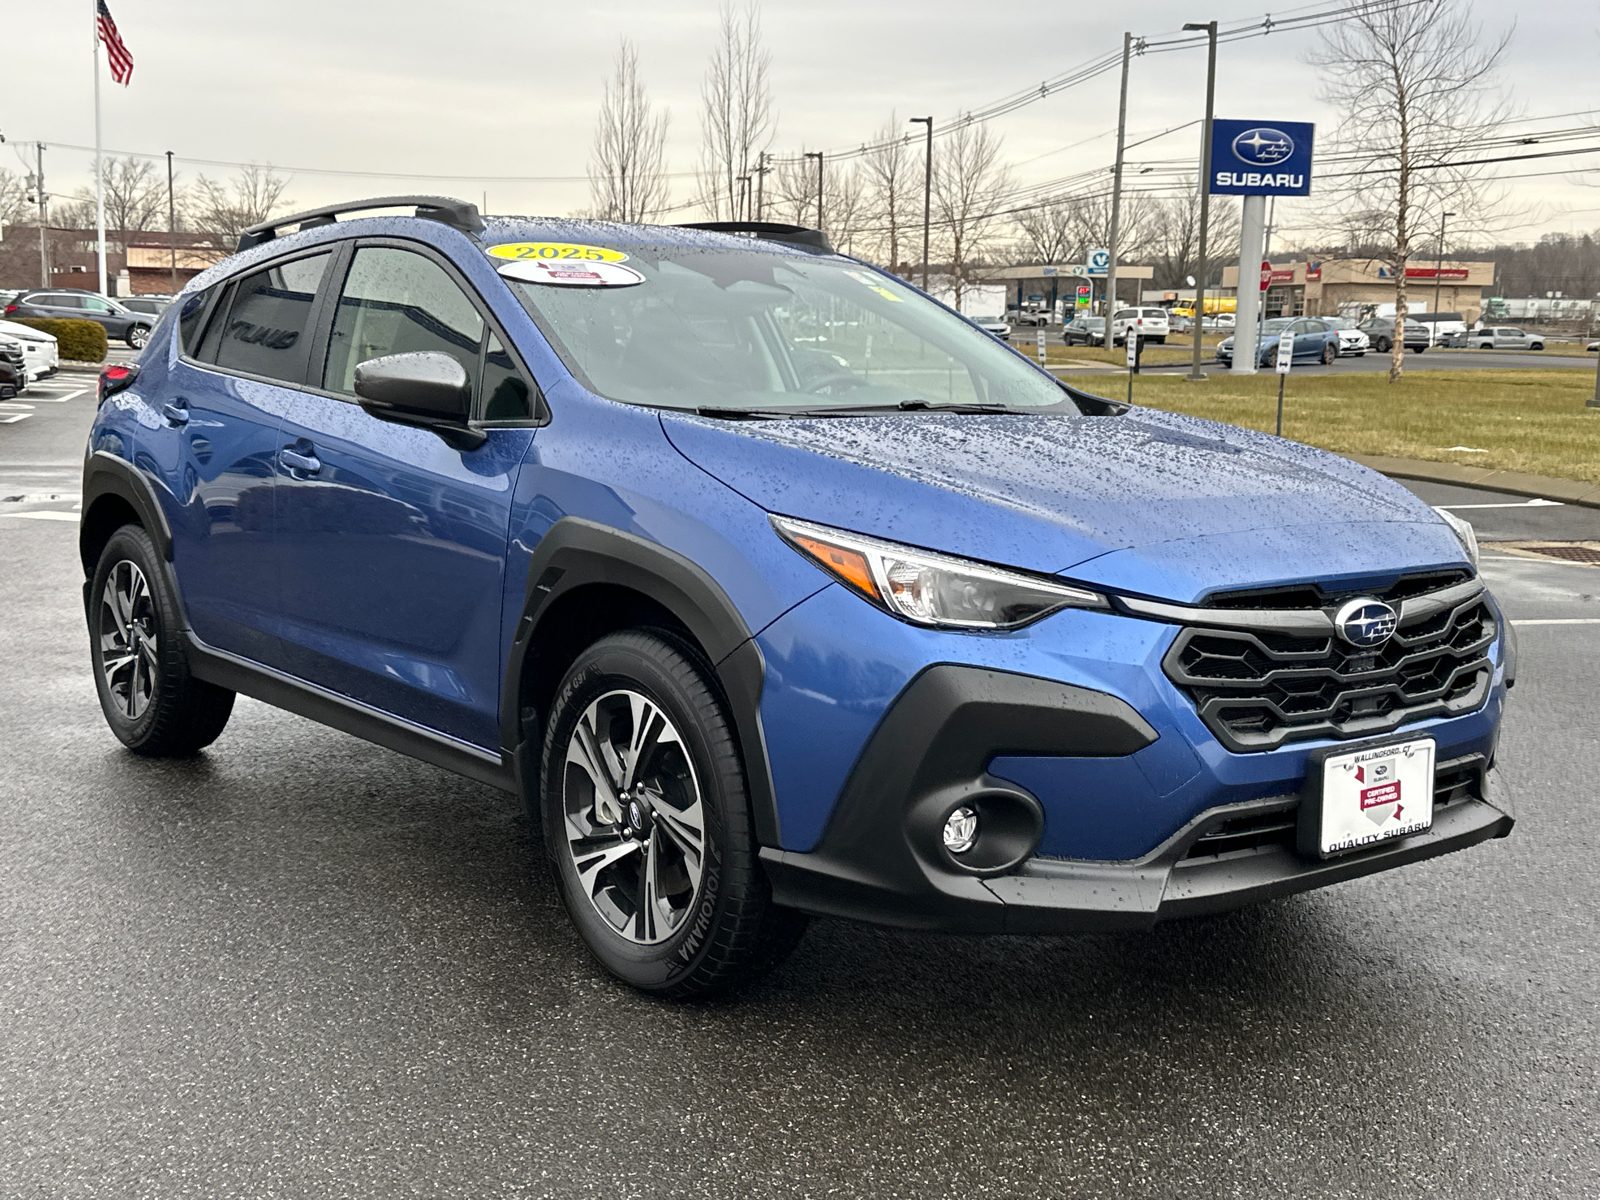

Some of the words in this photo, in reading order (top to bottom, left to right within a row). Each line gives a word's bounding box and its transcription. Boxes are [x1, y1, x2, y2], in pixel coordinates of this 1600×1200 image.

[1216, 172, 1303, 188] SUBARU
[516, 247, 604, 260] 2025
[1367, 786, 1395, 797] CERTIFIED
[1364, 793, 1398, 806] PRE-OWNED
[1329, 833, 1380, 852] QUALITY
[1383, 821, 1429, 838] SUBARU
[678, 866, 720, 961] YOKOHAMA
